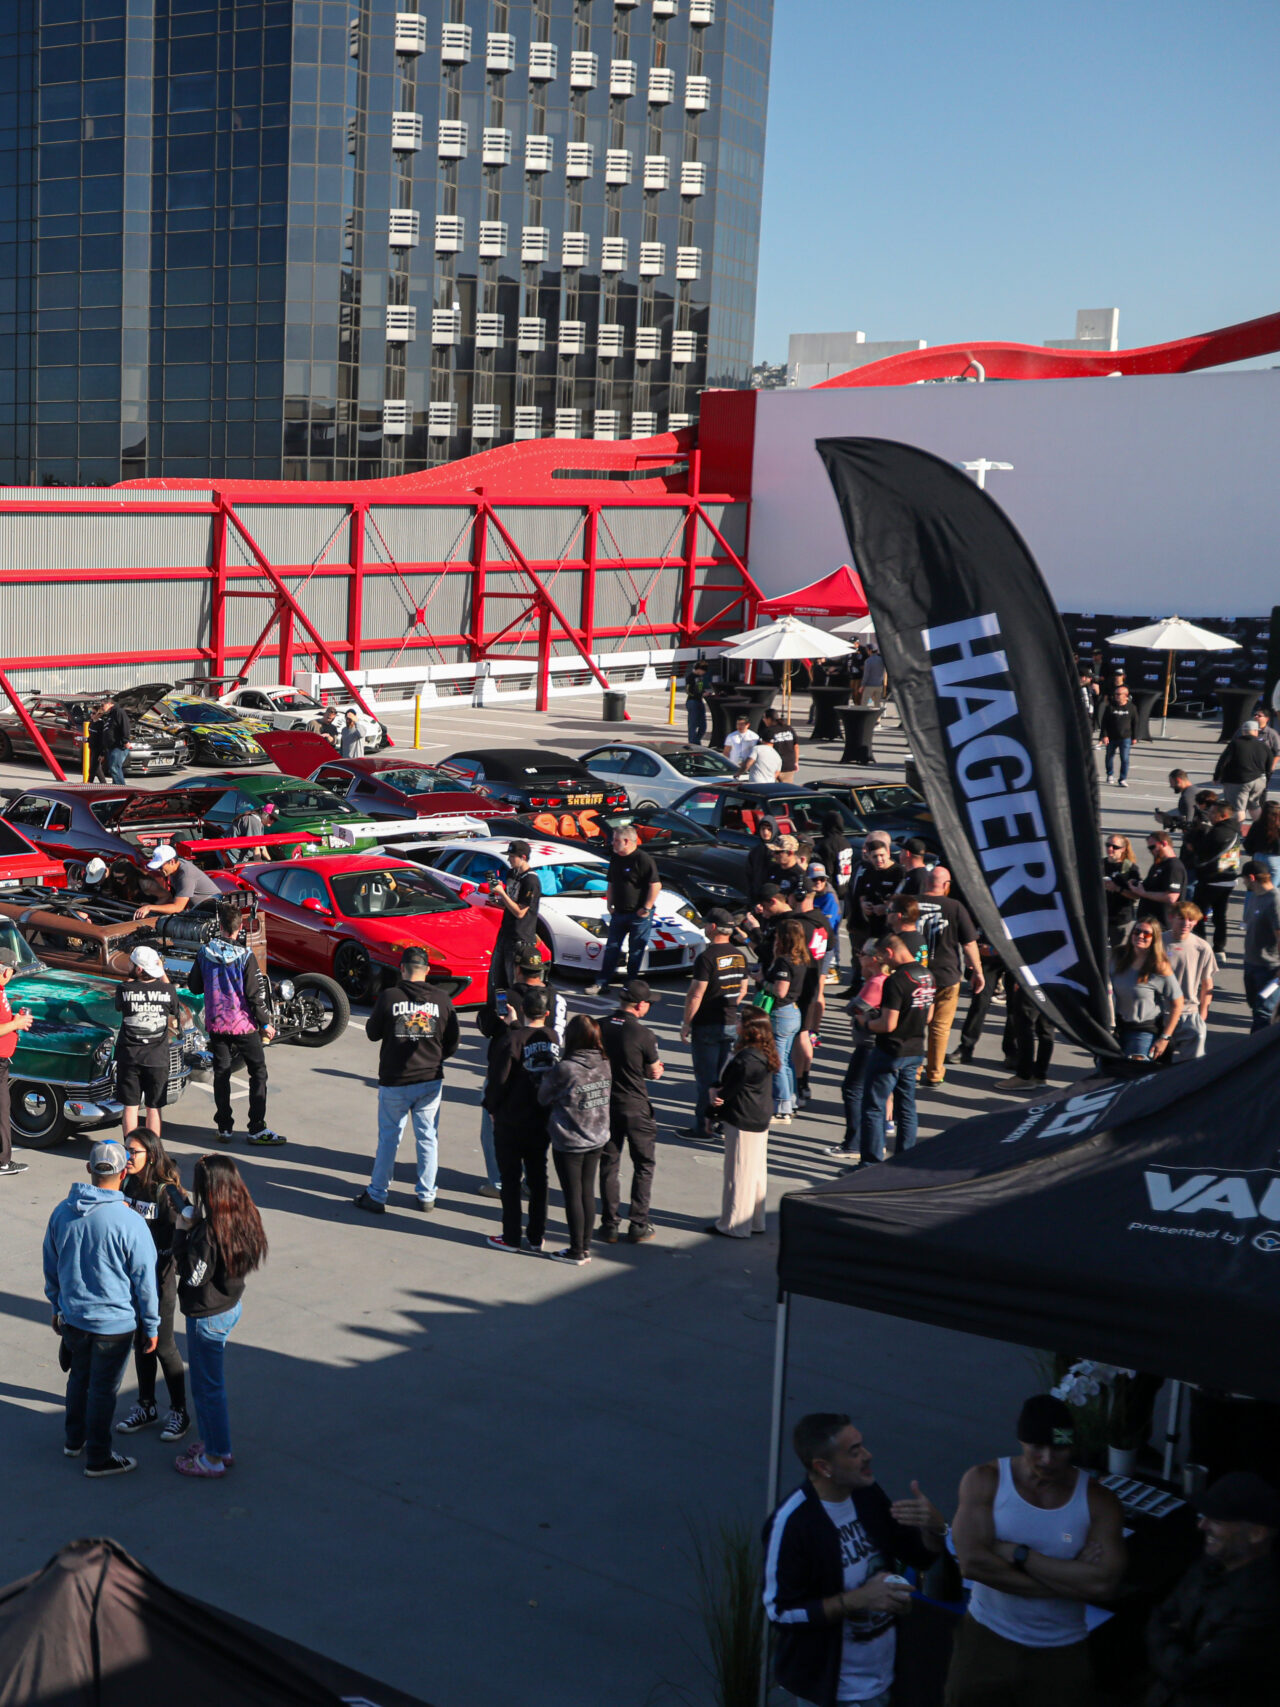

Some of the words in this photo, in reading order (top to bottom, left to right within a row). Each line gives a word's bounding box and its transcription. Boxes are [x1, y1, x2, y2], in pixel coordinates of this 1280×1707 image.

[567, 797, 602, 805] SHERIFF
[921, 612, 1090, 996] HAGERTY
[122, 990, 146, 1002] Wink
[147, 990, 171, 1002] Wink
[392, 1001, 439, 1018] COLUMBIA
[1127, 1221, 1219, 1239] presented
[1221, 1231, 1245, 1245] by
